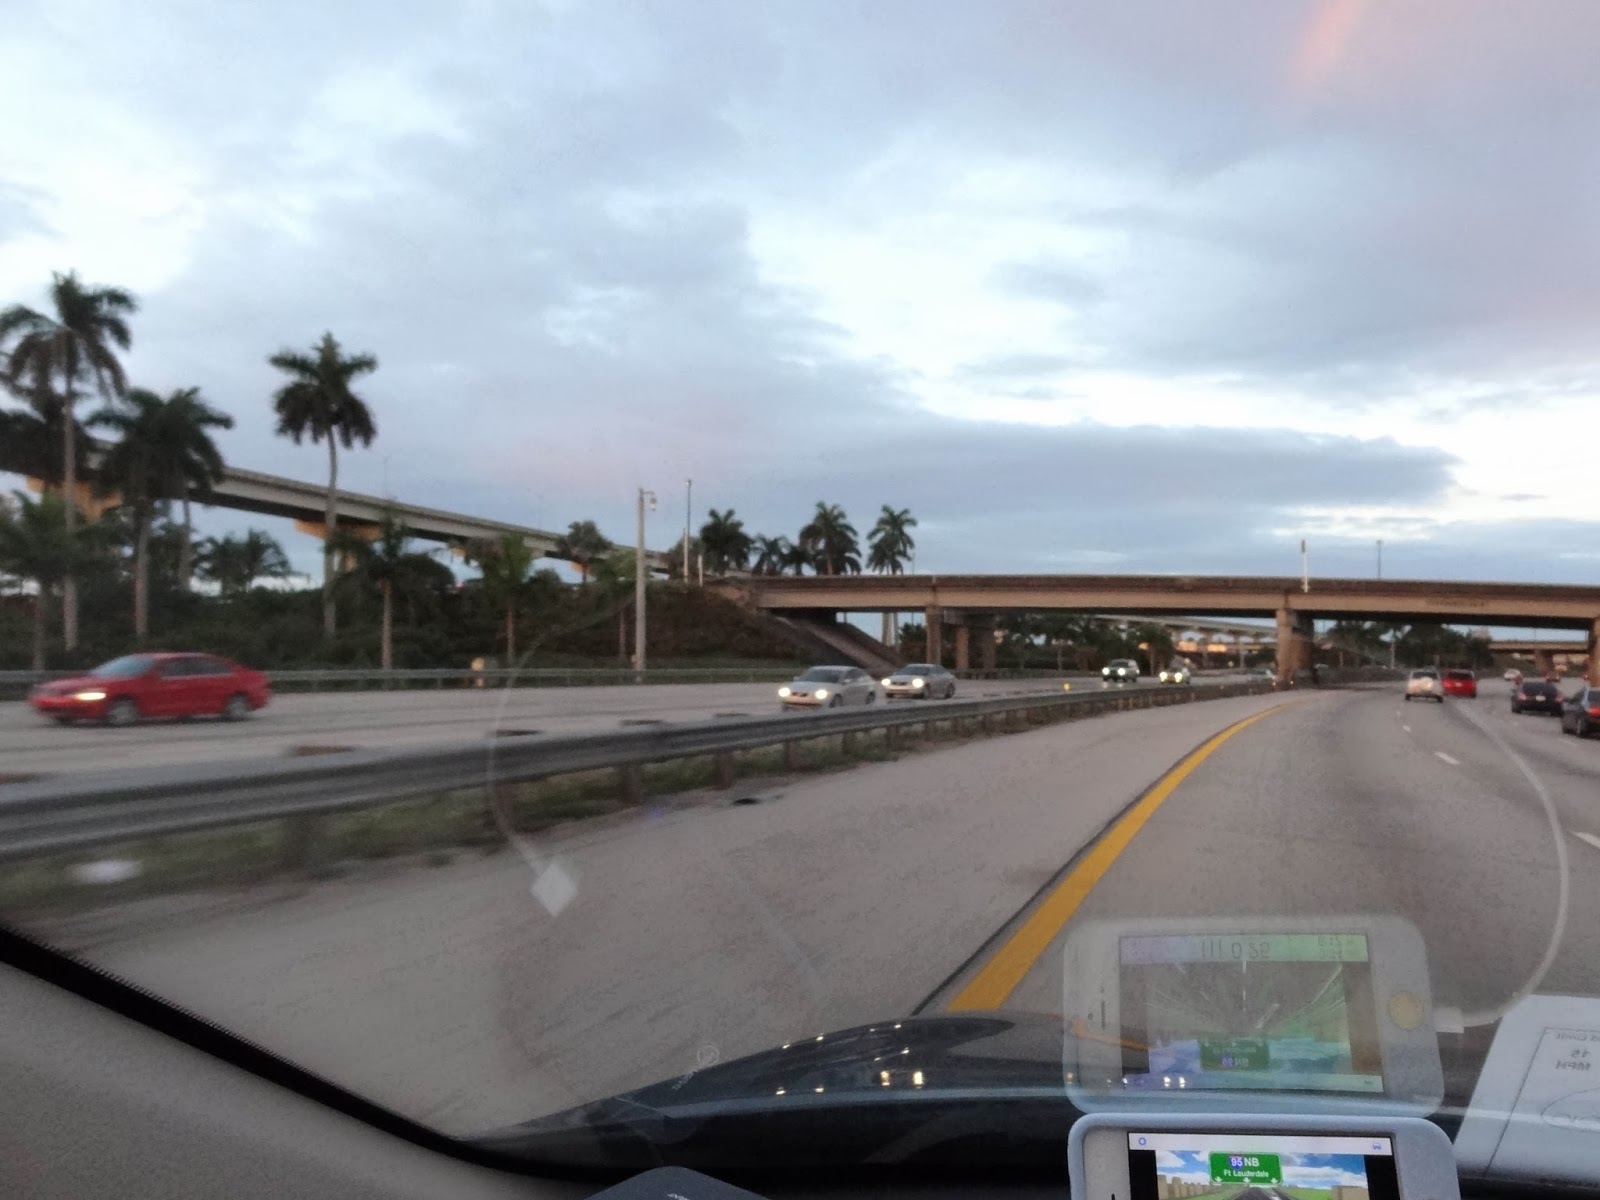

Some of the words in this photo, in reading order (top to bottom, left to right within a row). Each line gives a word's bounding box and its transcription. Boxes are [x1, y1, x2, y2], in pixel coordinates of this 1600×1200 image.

[1230, 1156, 1243, 1167] 95
[1244, 1156, 1260, 1167] NB
[1223, 1169, 1232, 1177] Ft
[1232, 1169, 1269, 1178] Lauderdale
